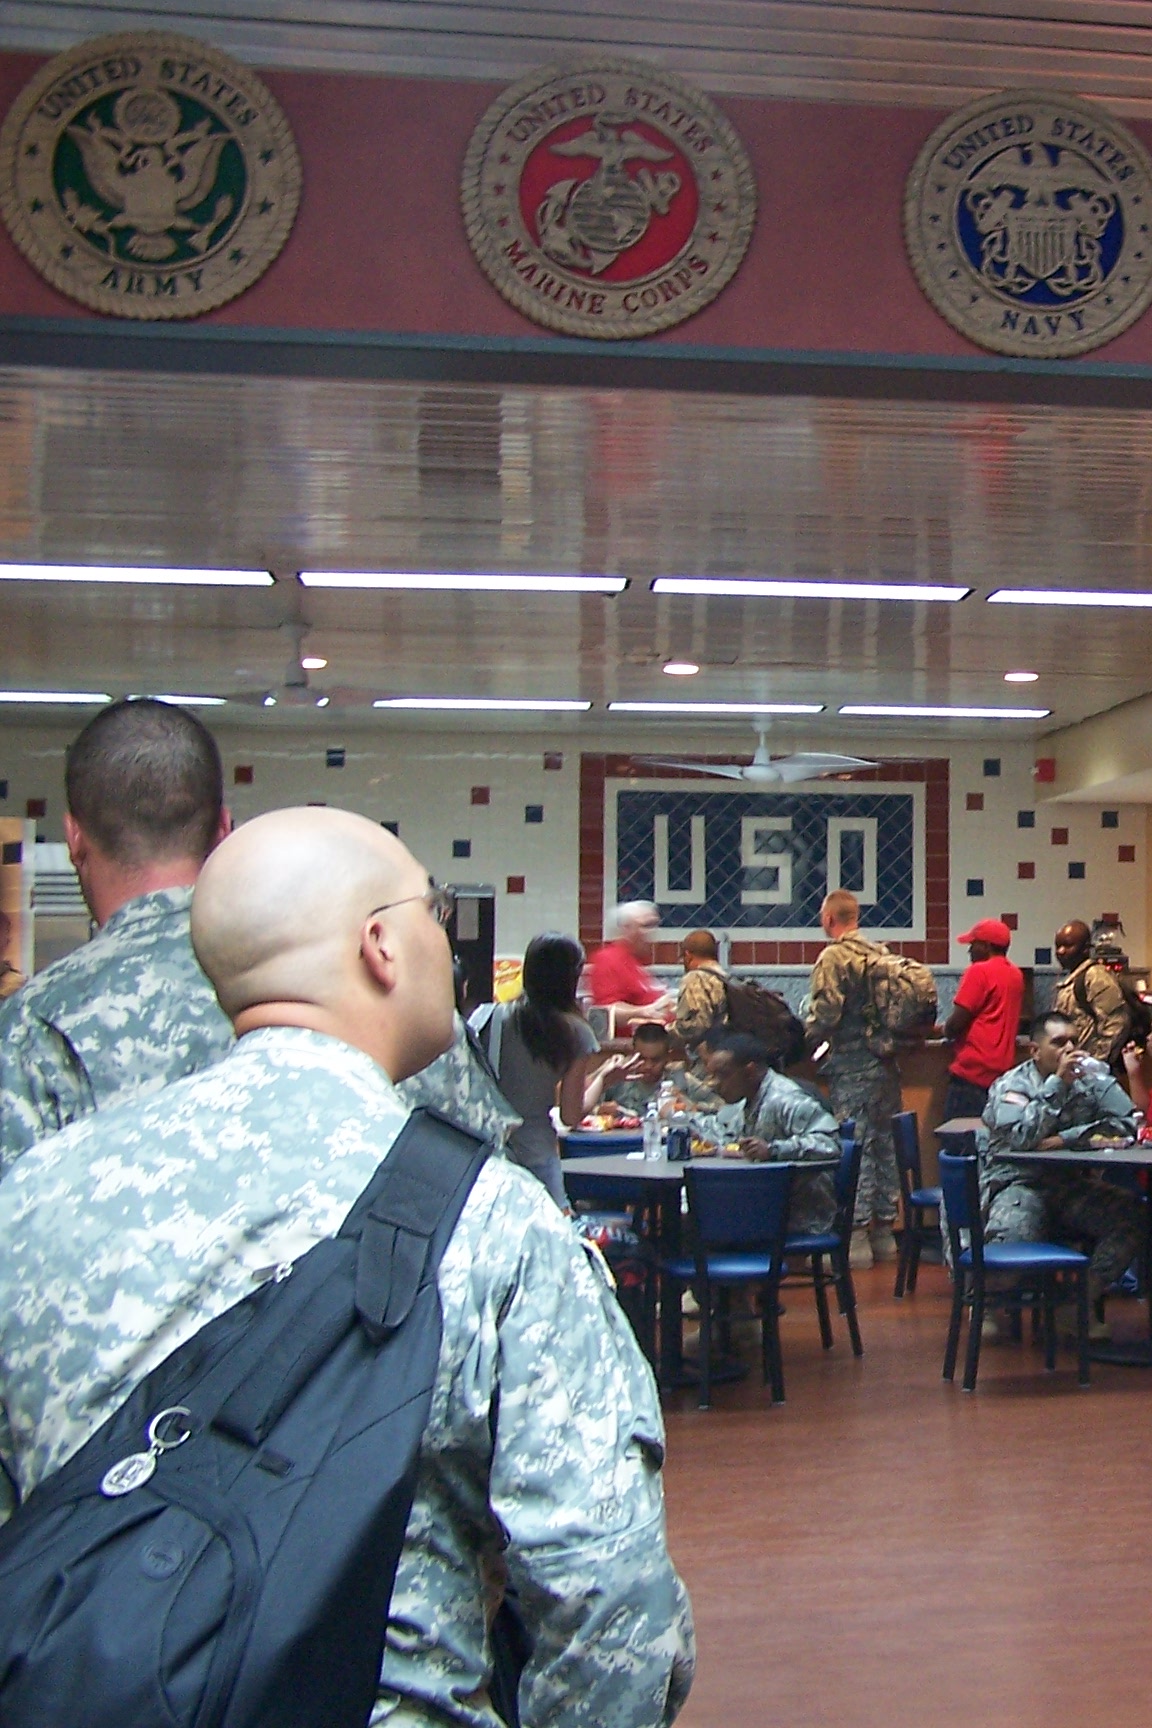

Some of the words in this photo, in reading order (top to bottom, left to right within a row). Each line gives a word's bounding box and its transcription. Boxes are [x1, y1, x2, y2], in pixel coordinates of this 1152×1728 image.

[38, 56, 141, 121] UNITED
[159, 58, 259, 127] STATES
[505, 84, 606, 143] UNITED
[624, 86, 715, 153] STATES
[943, 114, 1034, 171] UNITED
[1050, 117, 1136, 182] STATES
[100, 268, 205, 297] ARMY
[504, 238, 605, 315] MARINE
[623, 255, 709, 314] CORPS
[999, 308, 1086, 336] NAVY
[653, 813, 879, 906] USO
